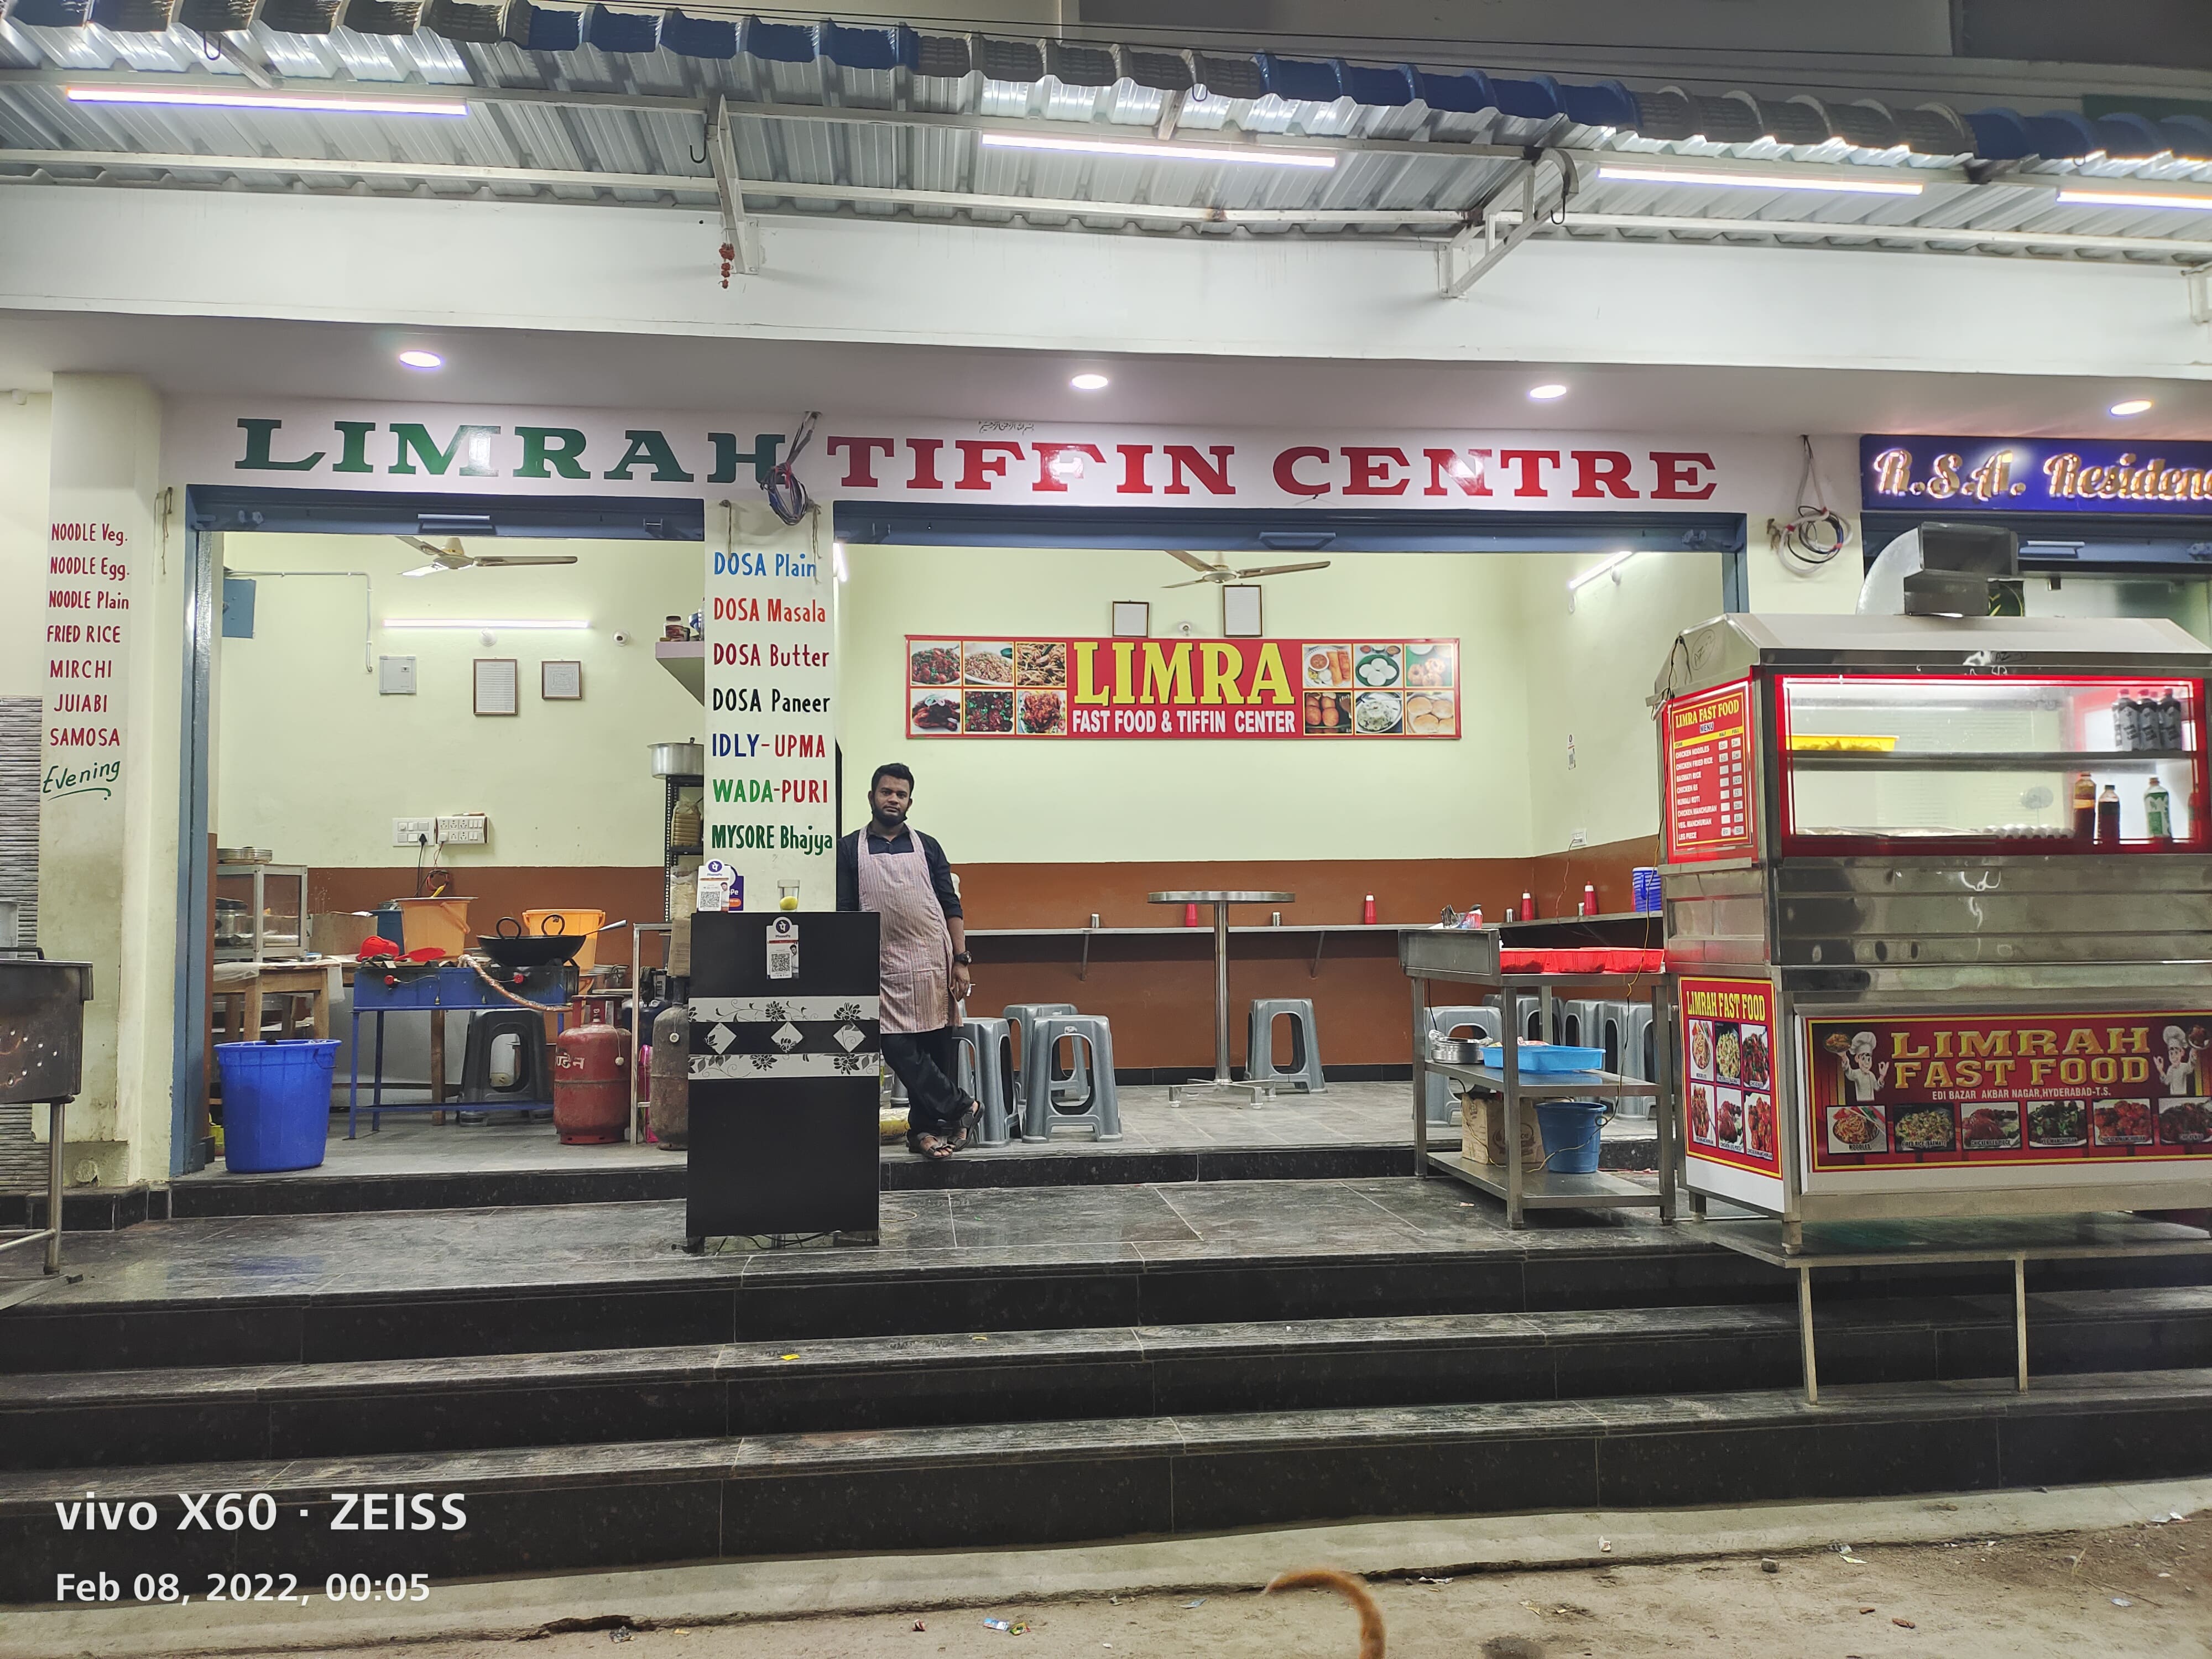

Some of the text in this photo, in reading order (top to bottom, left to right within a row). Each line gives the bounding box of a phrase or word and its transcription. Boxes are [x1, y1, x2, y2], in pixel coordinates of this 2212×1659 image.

[234, 418, 1718, 501] LIMRAH TIFFIN CENTRE
[51, 523, 128, 546] NOODLE Veg.
[50, 556, 130, 581] NOODLE Egg.
[713, 552, 817, 578] DOSA Plain
[49, 590, 129, 610] NOODLE Plain
[713, 597, 826, 623] DOSA Masala
[46, 625, 121, 644] FRIED RICE
[713, 642, 830, 667] DOSA Butter
[50, 660, 112, 679] MIRCHI
[1074, 641, 1295, 706] LIMRA
[713, 687, 831, 713] DOSA Paneer
[1073, 709, 1295, 733] FAST FOOD & TIFFIN CENTER
[1675, 699, 1739, 728] LIMRA FAST FOOD
[50, 727, 121, 747] SAMOSA
[1700, 722, 1714, 733] MENU
[42, 760, 121, 794] Evening
[712, 825, 833, 856] MYSORE Bhajya
[1686, 990, 1766, 1021] LIMRAH FAST FOOD
[1890, 1027, 2151, 1060] LIMRAH
[1894, 1056, 2151, 1089] FAST FOOD
[1932, 1091, 1947, 1100] EDI
[1949, 1090, 1976, 1100] BAZAR
[1981, 1089, 2010, 1099] AKBAR
